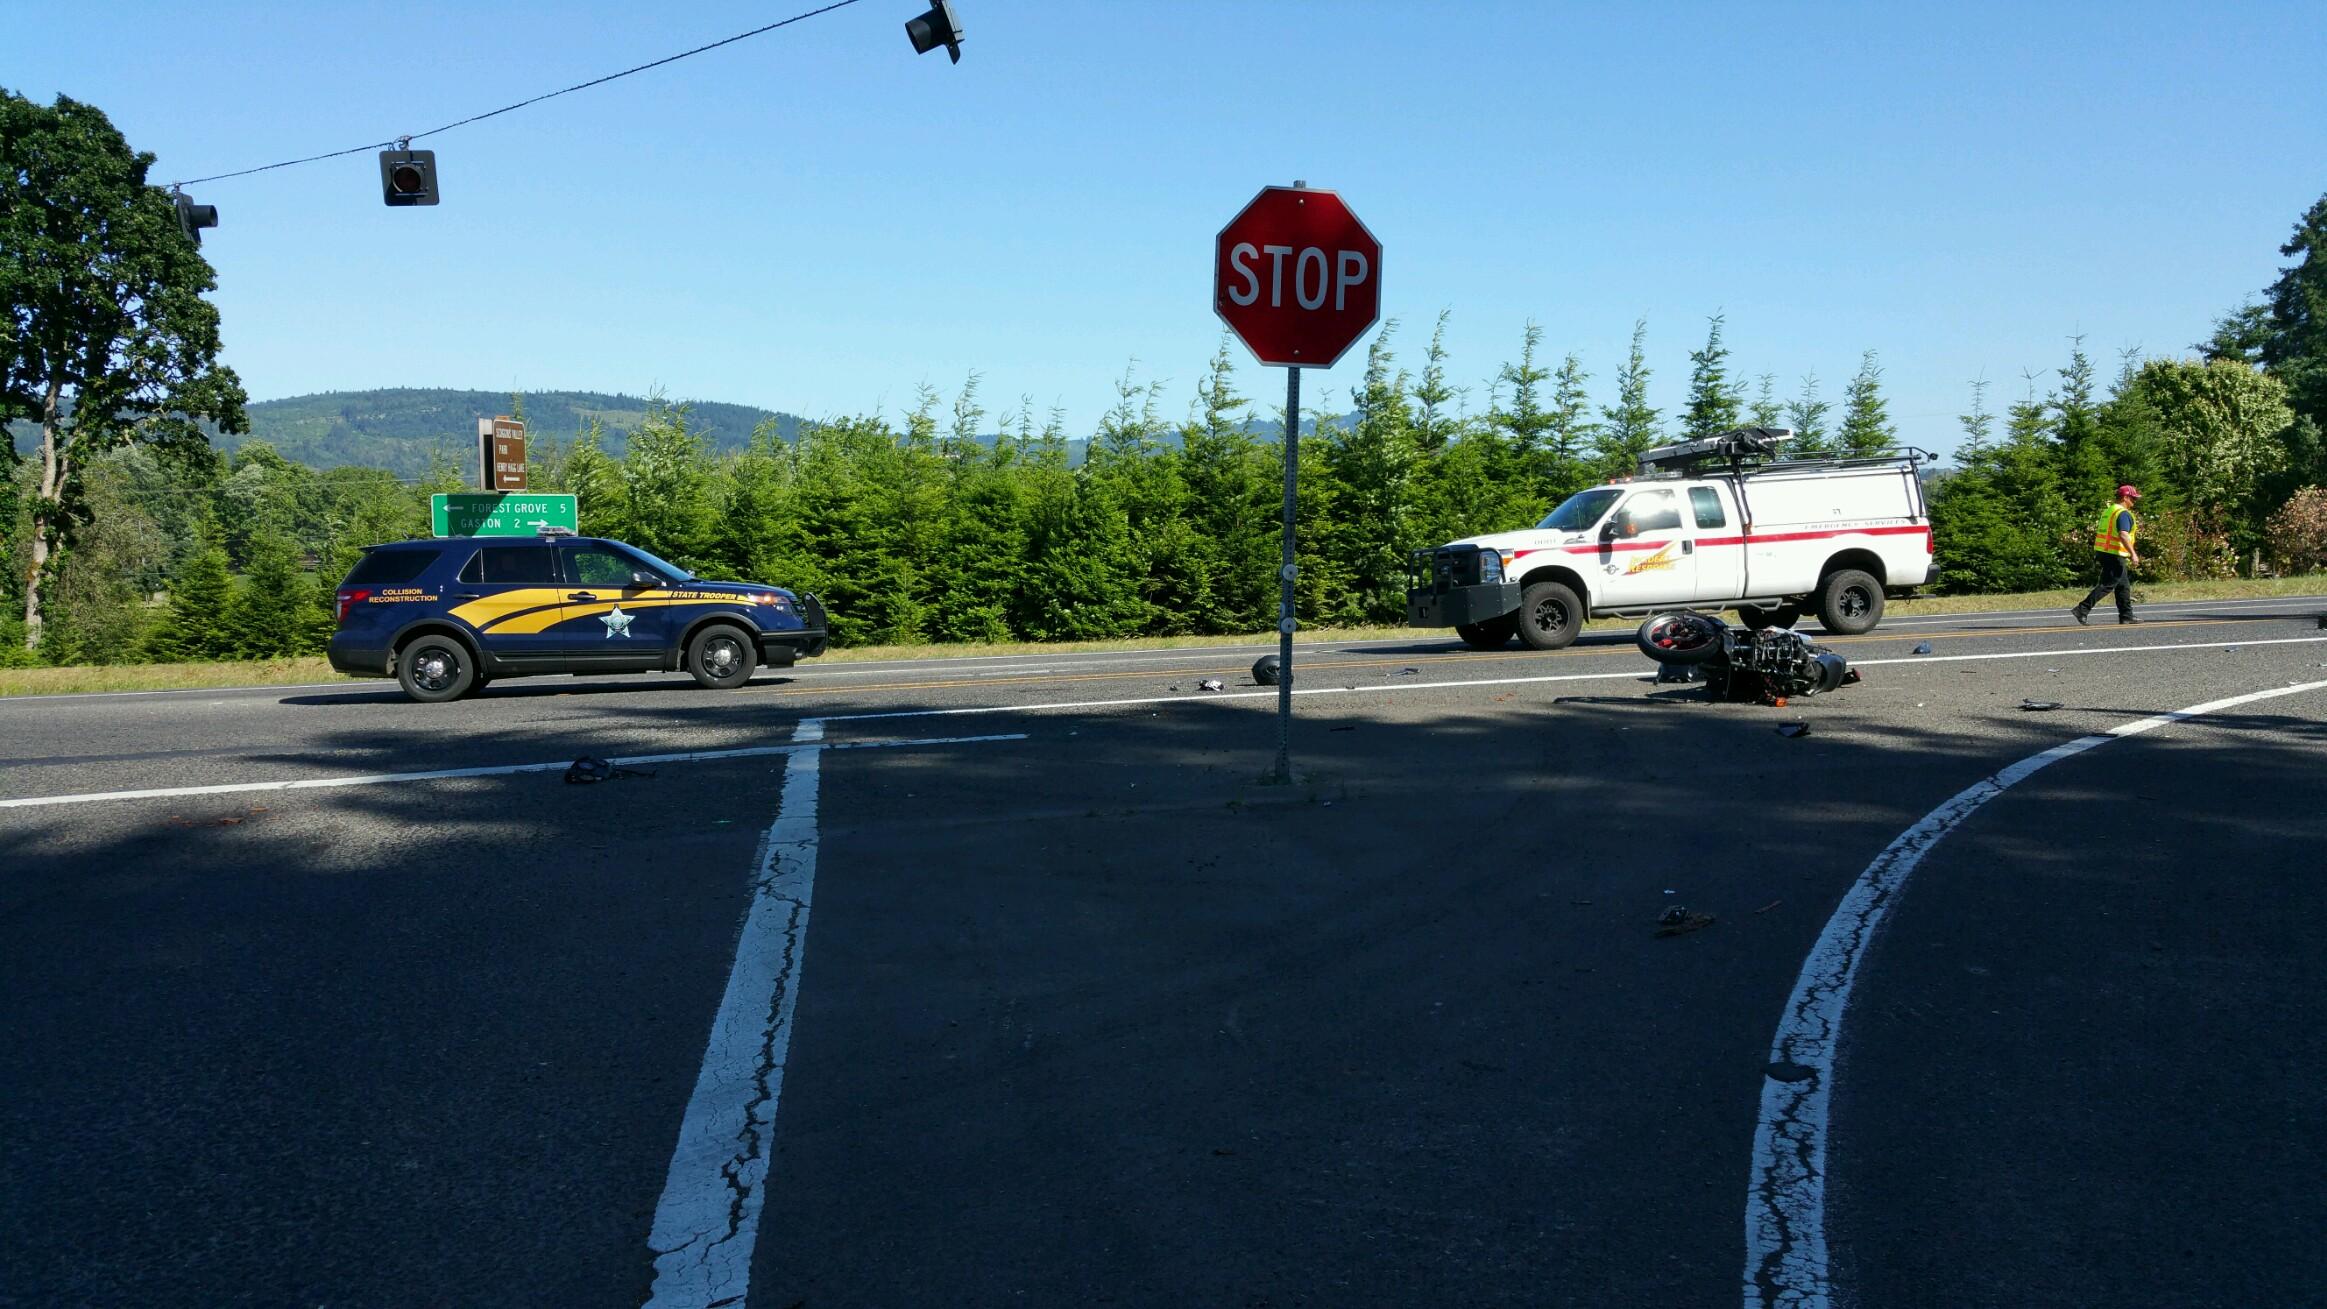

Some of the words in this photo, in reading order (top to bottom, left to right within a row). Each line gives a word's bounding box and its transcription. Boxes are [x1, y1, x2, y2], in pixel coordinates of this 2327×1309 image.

[1228, 242, 1368, 311] STOP
[472, 503, 511, 513] FOREST
[514, 503, 548, 513] GROVE
[559, 503, 566, 513] 5
[460, 518, 501, 528] GASTON
[514, 518, 521, 528] 2
[382, 588, 423, 596] COLLISION
[672, 591, 698, 599] STATE
[699, 592, 736, 600] TROOPER
[368, 595, 438, 603] RECONSTRUCTION
